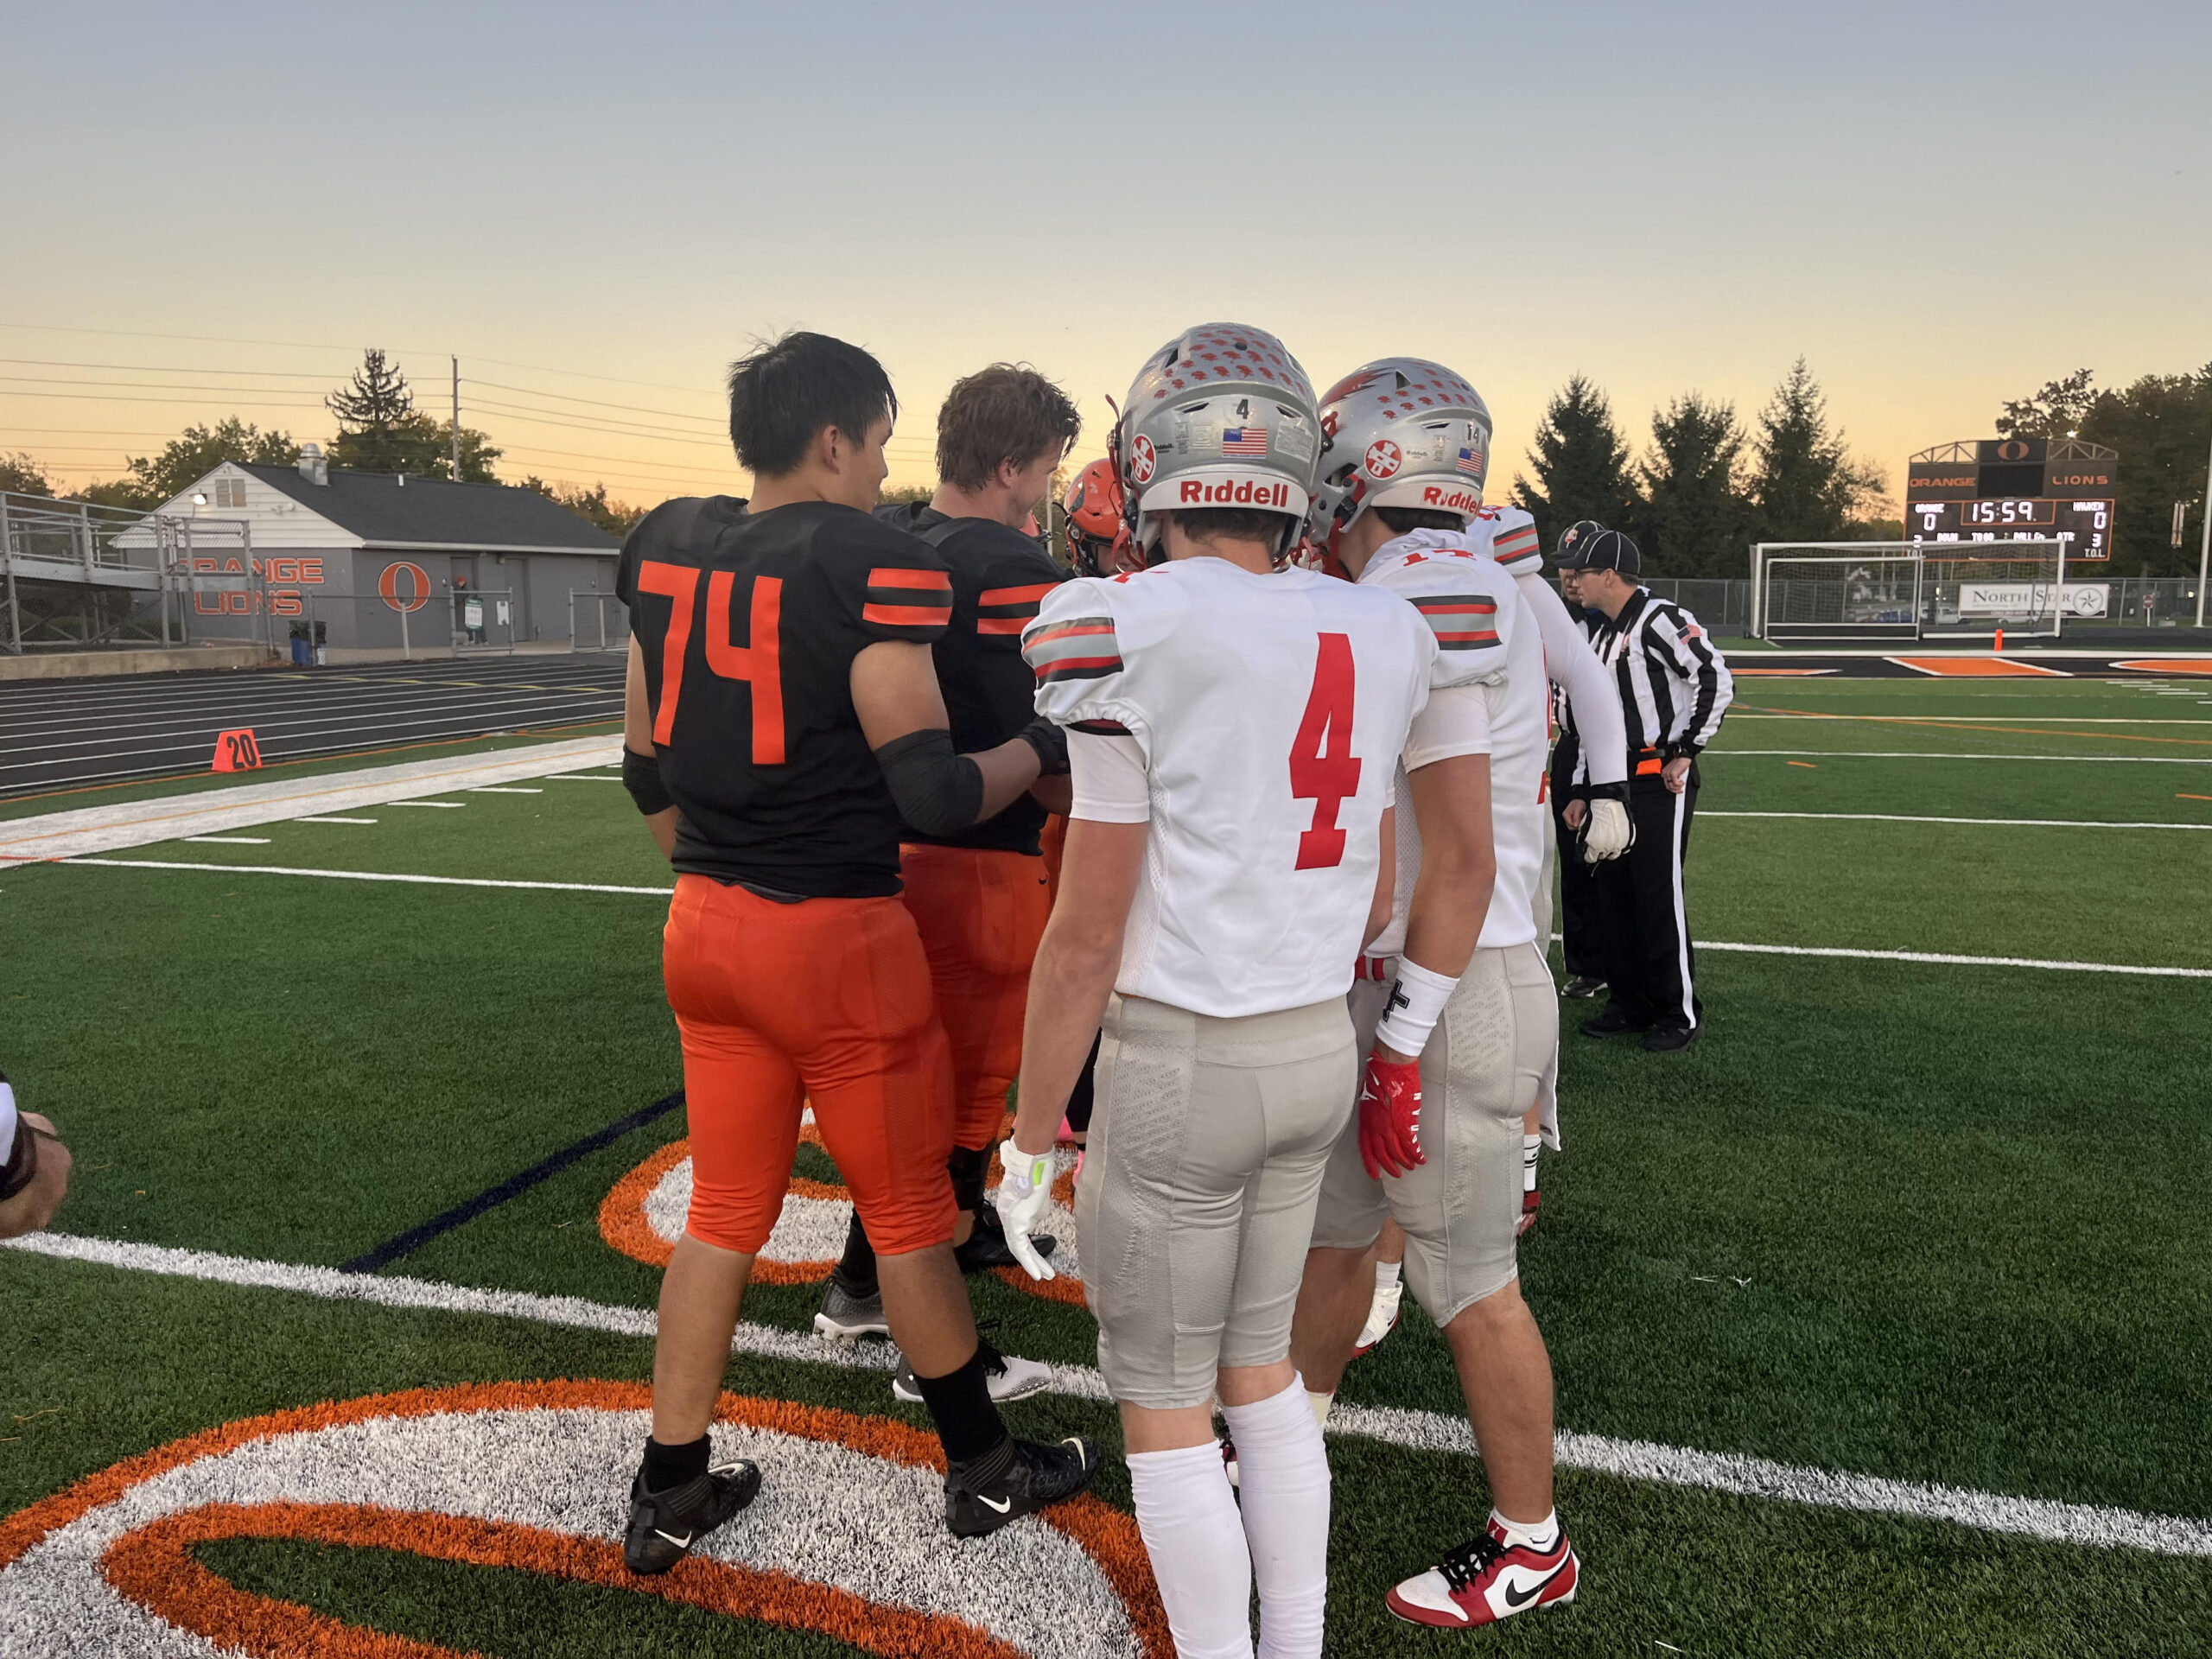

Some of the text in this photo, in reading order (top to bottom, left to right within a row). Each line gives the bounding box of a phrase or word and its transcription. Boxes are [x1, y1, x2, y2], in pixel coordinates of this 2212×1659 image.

[1236, 398, 1249, 420] 4
[1998, 441, 2029, 461] O
[1910, 475, 2109, 487] ORANGE LIONS
[1180, 480, 1288, 508] Riddell
[1923, 513, 1936, 531] 0
[2094, 512, 2107, 529] 0
[2092, 533, 2101, 548] 3
[177, 558, 324, 584] RANGE
[378, 562, 431, 613] O
[194, 590, 302, 615] LIONS
[638, 560, 785, 765] 74
[226, 734, 257, 769] 20
[1289, 632, 1362, 871] 4
